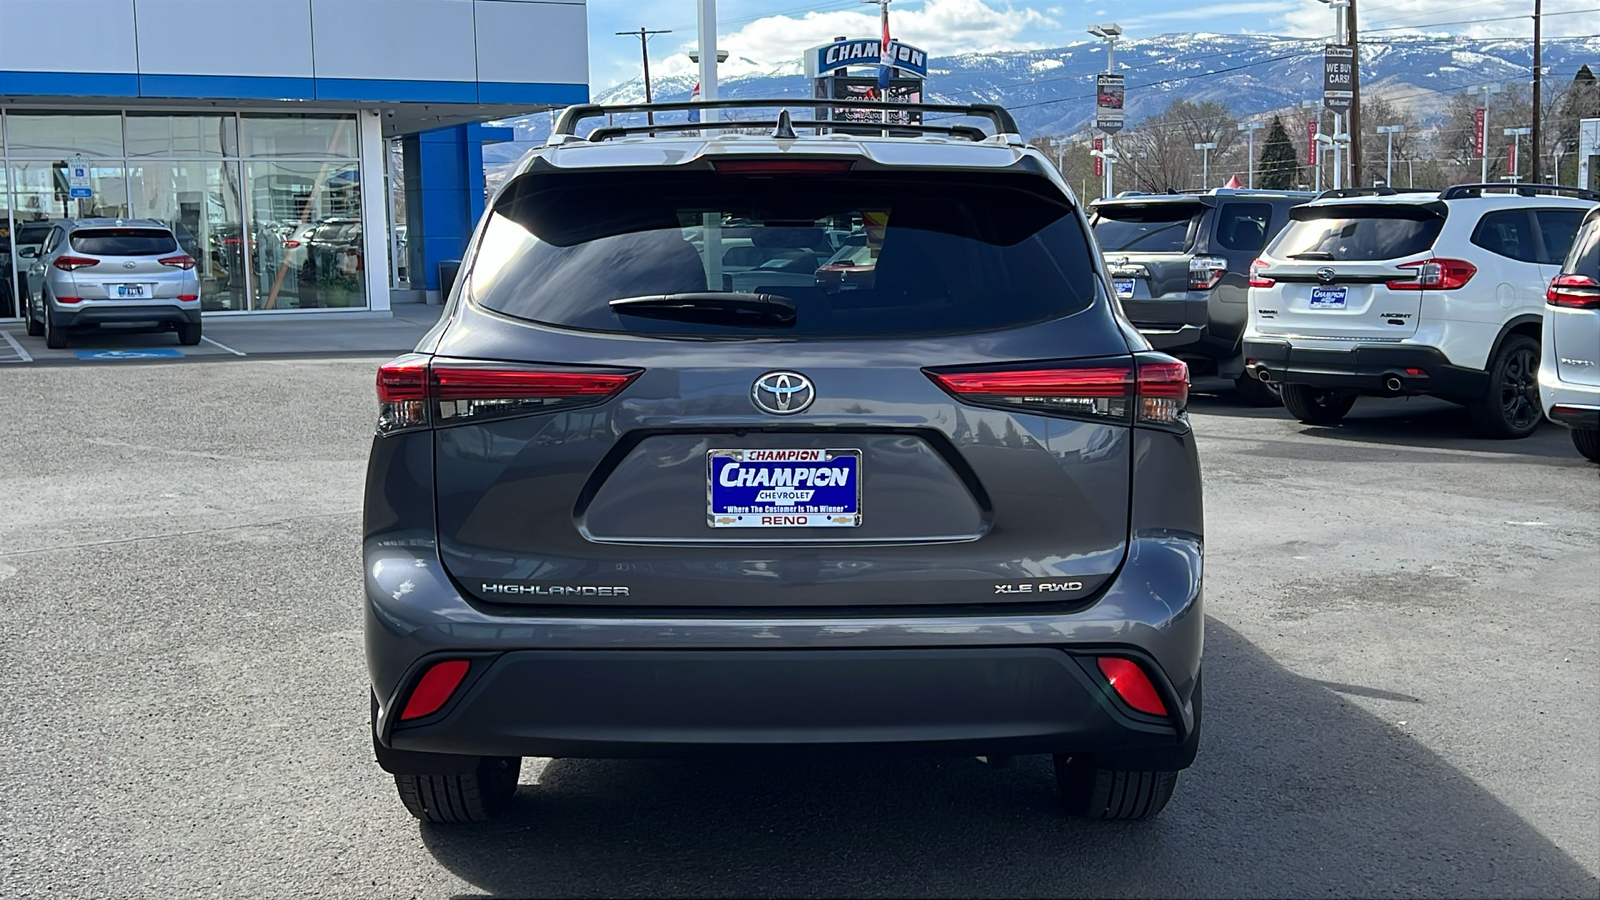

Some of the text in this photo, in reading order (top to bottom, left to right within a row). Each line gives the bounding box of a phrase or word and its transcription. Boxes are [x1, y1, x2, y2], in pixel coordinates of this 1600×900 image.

[826, 42, 923, 67] CHAMION
[1326, 63, 1352, 74] WE BUY
[1329, 74, 1350, 84] CARS!
[1313, 290, 1345, 298] CHAMPION
[748, 450, 819, 461] CHAMPION
[719, 463, 849, 487] CHAMPION
[759, 491, 810, 500] CHEVROLET
[751, 505, 763, 513] The
[764, 505, 797, 513] Customer
[798, 505, 805, 513] Is
[806, 505, 818, 513] The
[761, 516, 808, 525] RENO
[482, 583, 629, 597] HIGHLANDER
[994, 581, 1083, 594] XLE AWD
